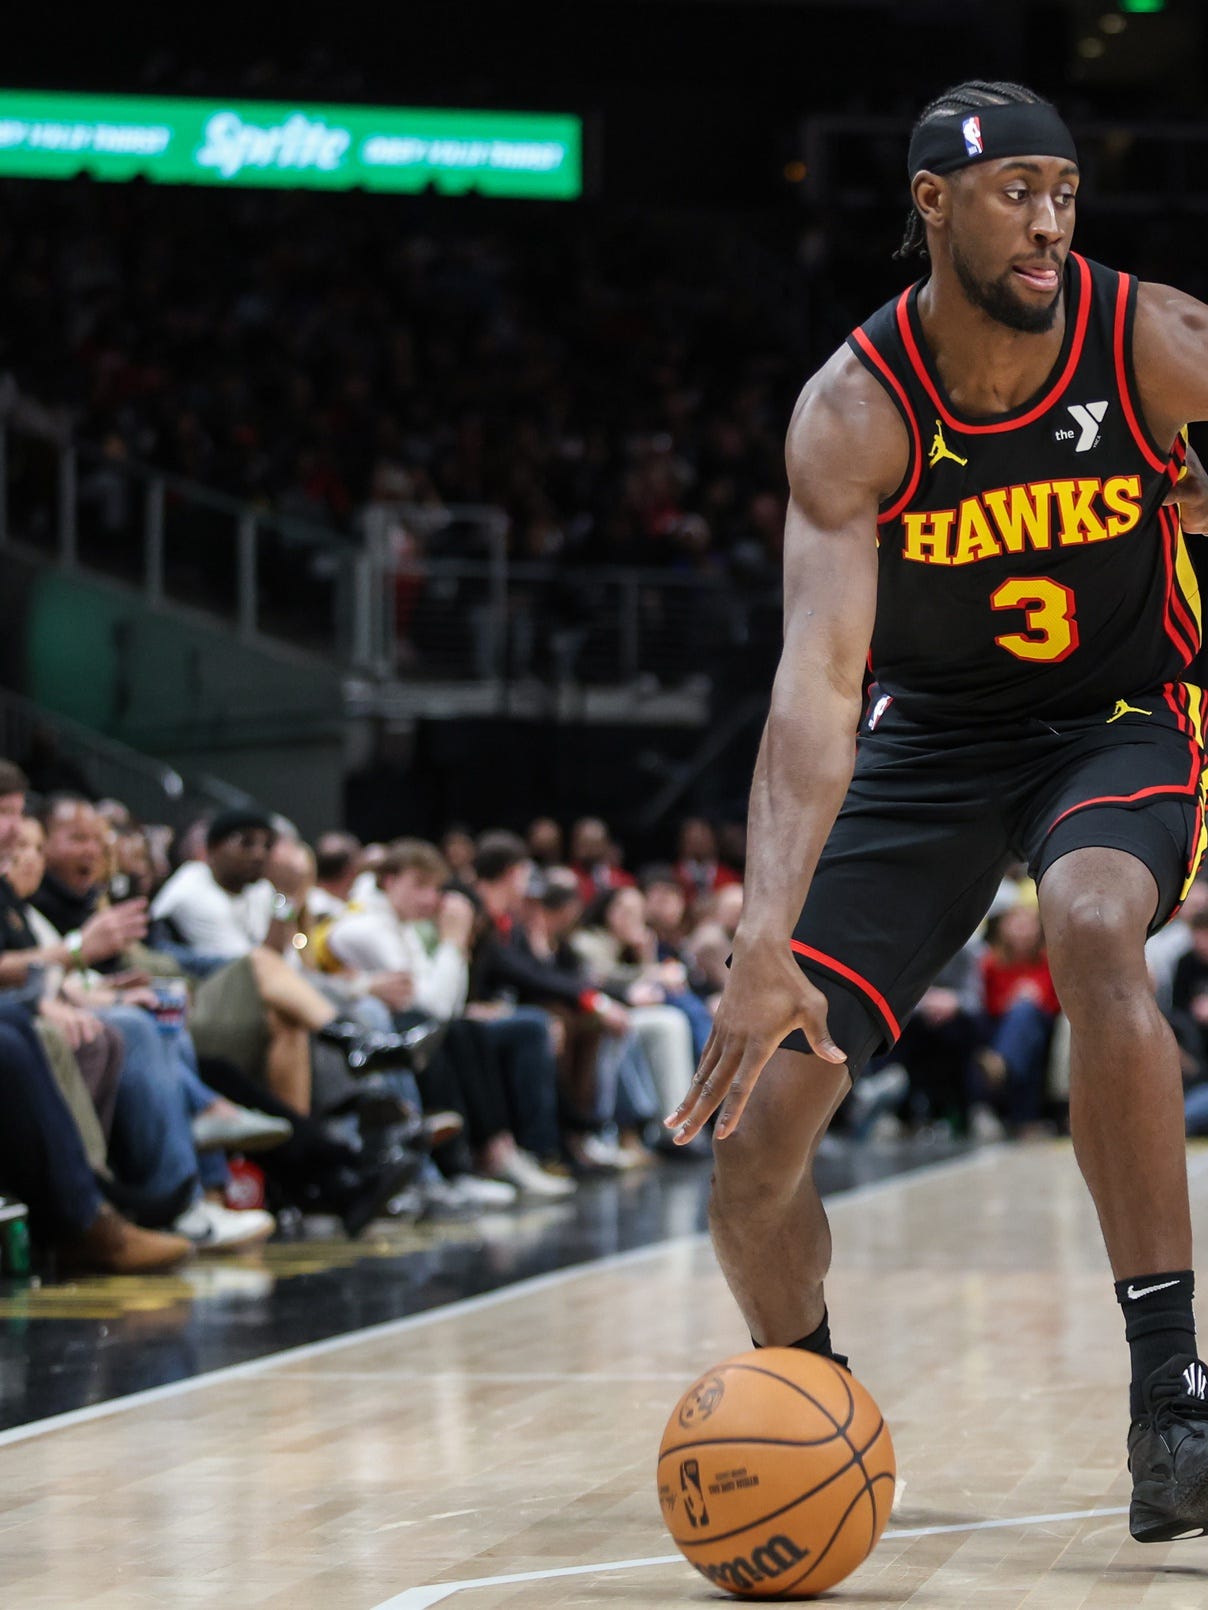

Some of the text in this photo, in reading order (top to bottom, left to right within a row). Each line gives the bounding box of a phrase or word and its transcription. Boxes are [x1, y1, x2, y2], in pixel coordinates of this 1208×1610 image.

[198, 112, 349, 175] Sprite
[1055, 429, 1075, 441] the
[901, 474, 1143, 566] HAWKS
[990, 576, 1080, 662] 3
